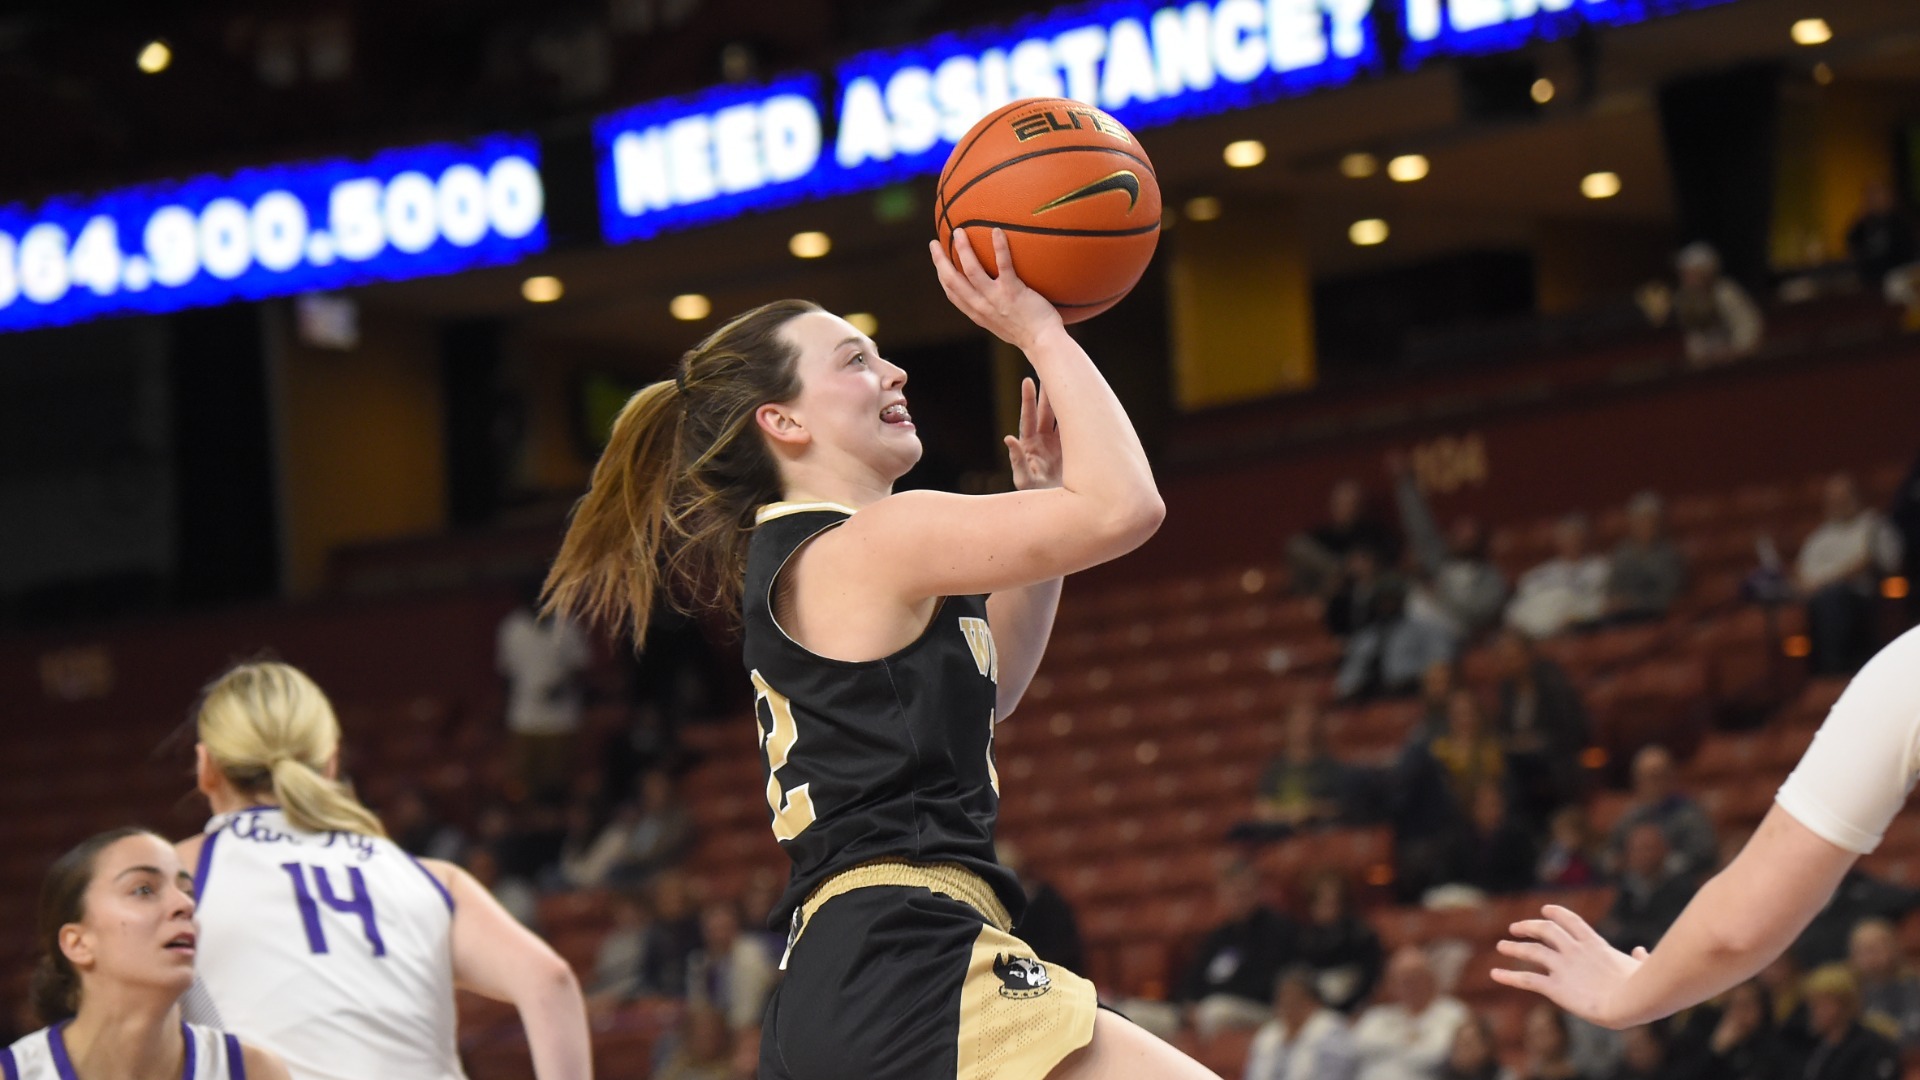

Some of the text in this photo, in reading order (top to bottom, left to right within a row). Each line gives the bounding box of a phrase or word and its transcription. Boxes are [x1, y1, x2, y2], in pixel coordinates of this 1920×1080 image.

[614, 0, 1372, 215] NEED ASSISTANCE?
[1011, 110, 1132, 144] ELITE
[280, 862, 386, 957] 14
